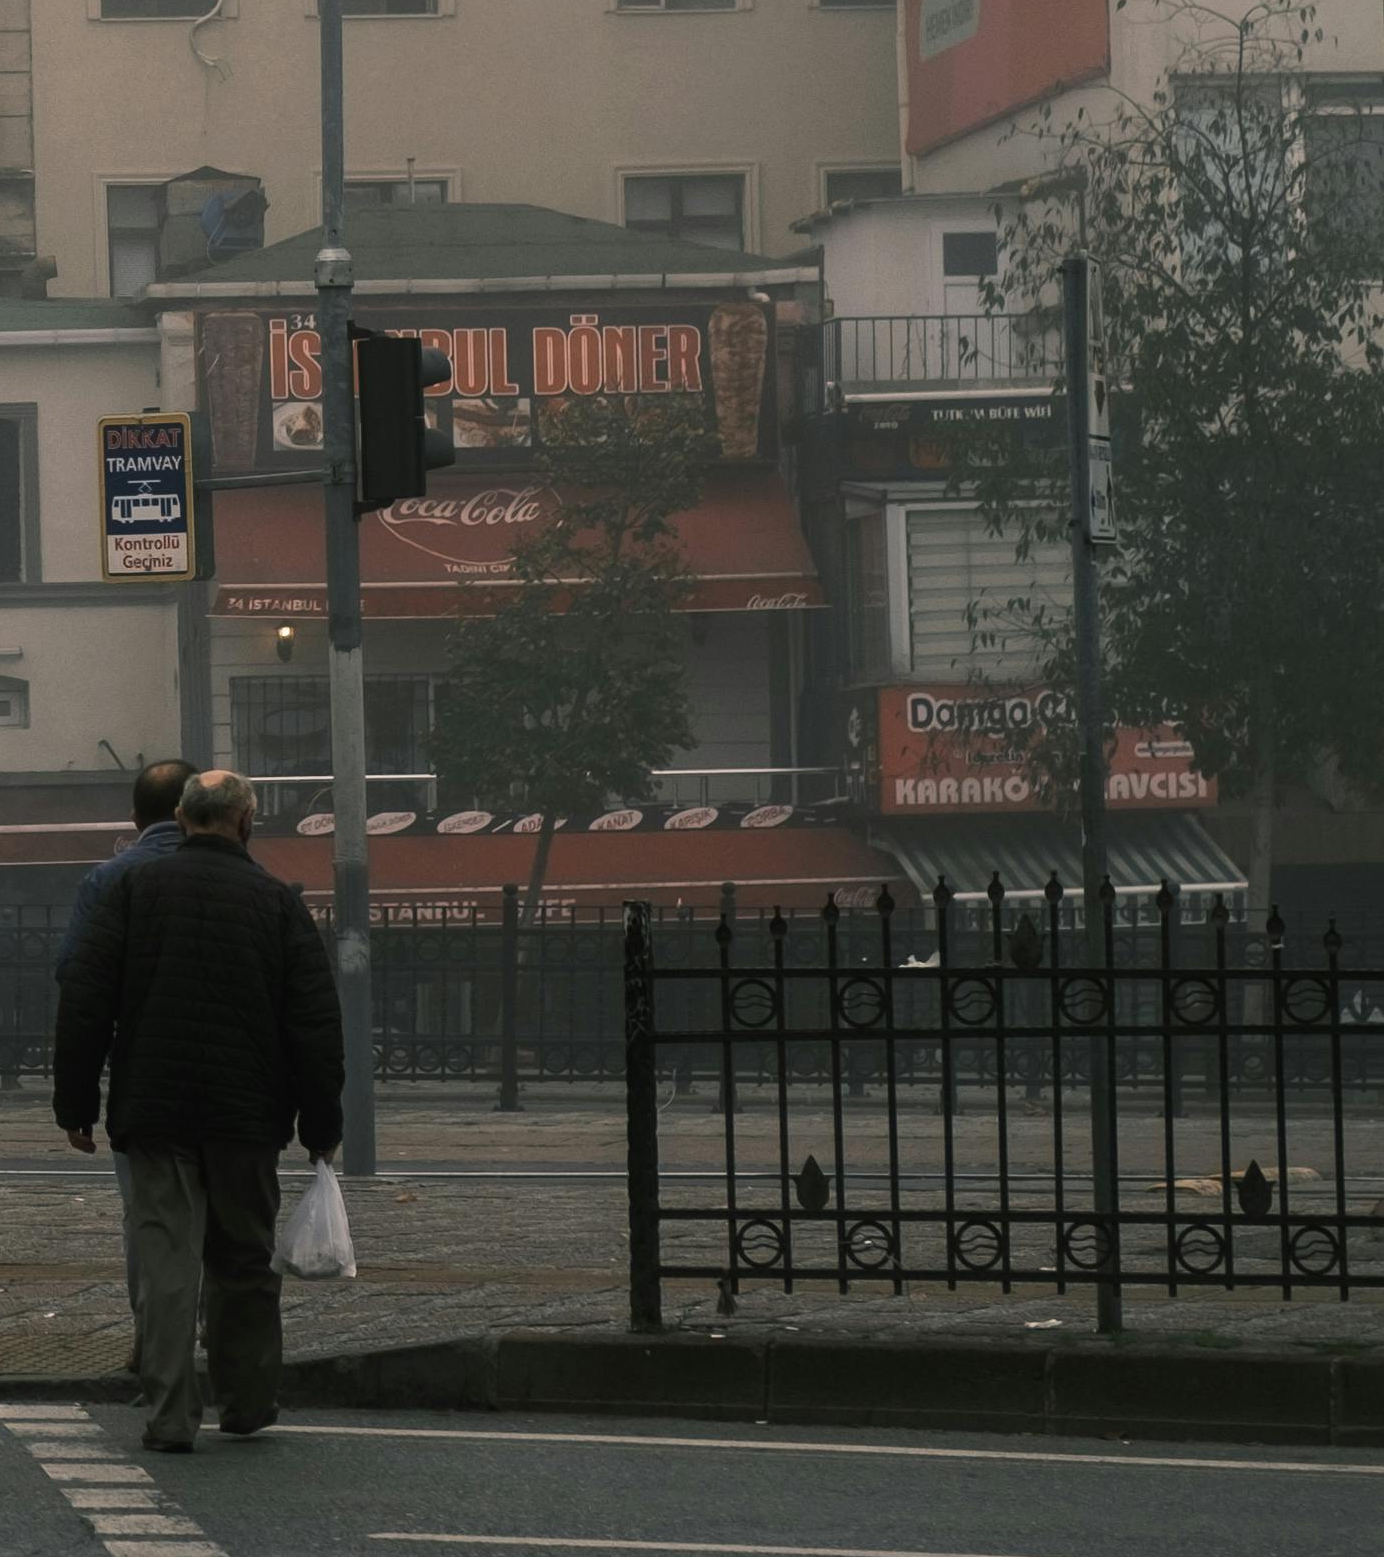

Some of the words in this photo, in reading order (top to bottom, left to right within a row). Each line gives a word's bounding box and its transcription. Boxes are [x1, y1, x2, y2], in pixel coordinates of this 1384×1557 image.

[290, 314, 317, 329] 34
[532, 314, 704, 395] DÖNER
[106, 426, 182, 450] DİKKAT
[106, 455, 183, 473] TRAMVAY
[114, 535, 180, 551] Kontrollü
[248, 595, 323, 612] İSTANBUL
[894, 767, 1049, 805] KARAKÖ
